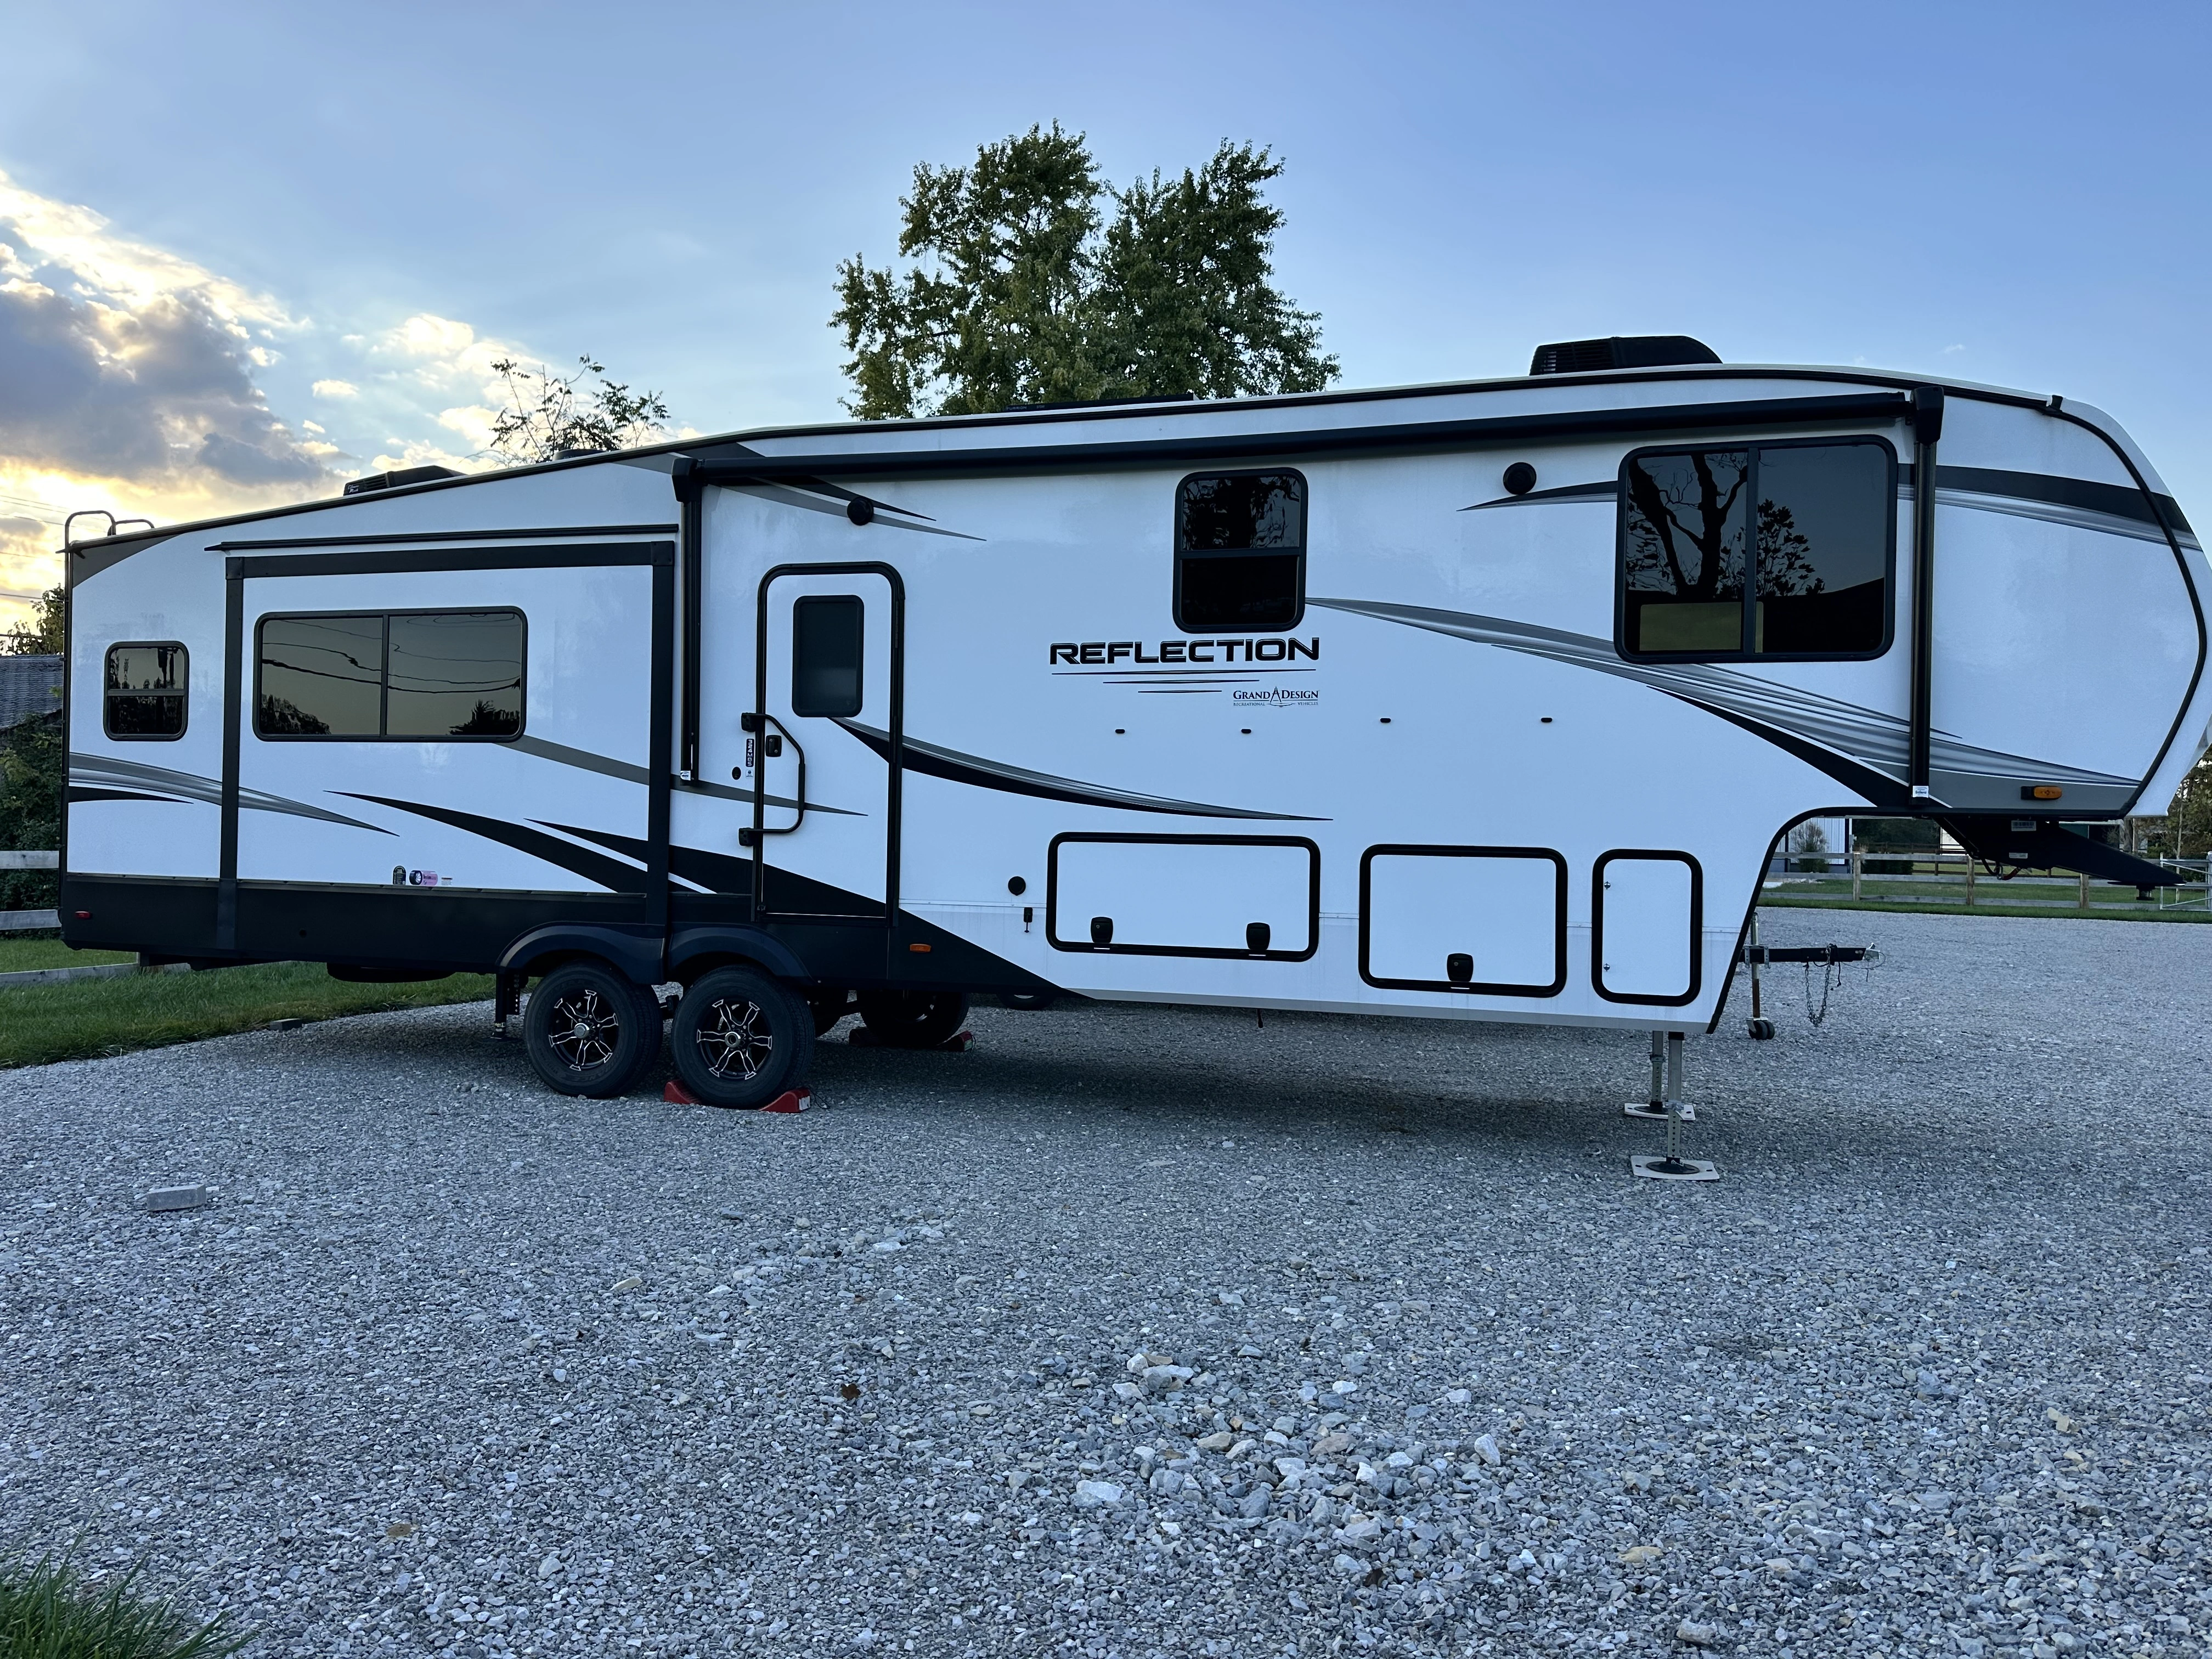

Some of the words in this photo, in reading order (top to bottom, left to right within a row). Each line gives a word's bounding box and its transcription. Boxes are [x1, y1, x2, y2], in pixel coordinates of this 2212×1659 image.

[1050, 637, 1319, 664] REFLECTION
[1233, 690, 1270, 699] GRAND
[1282, 690, 1318, 698] DESIGN
